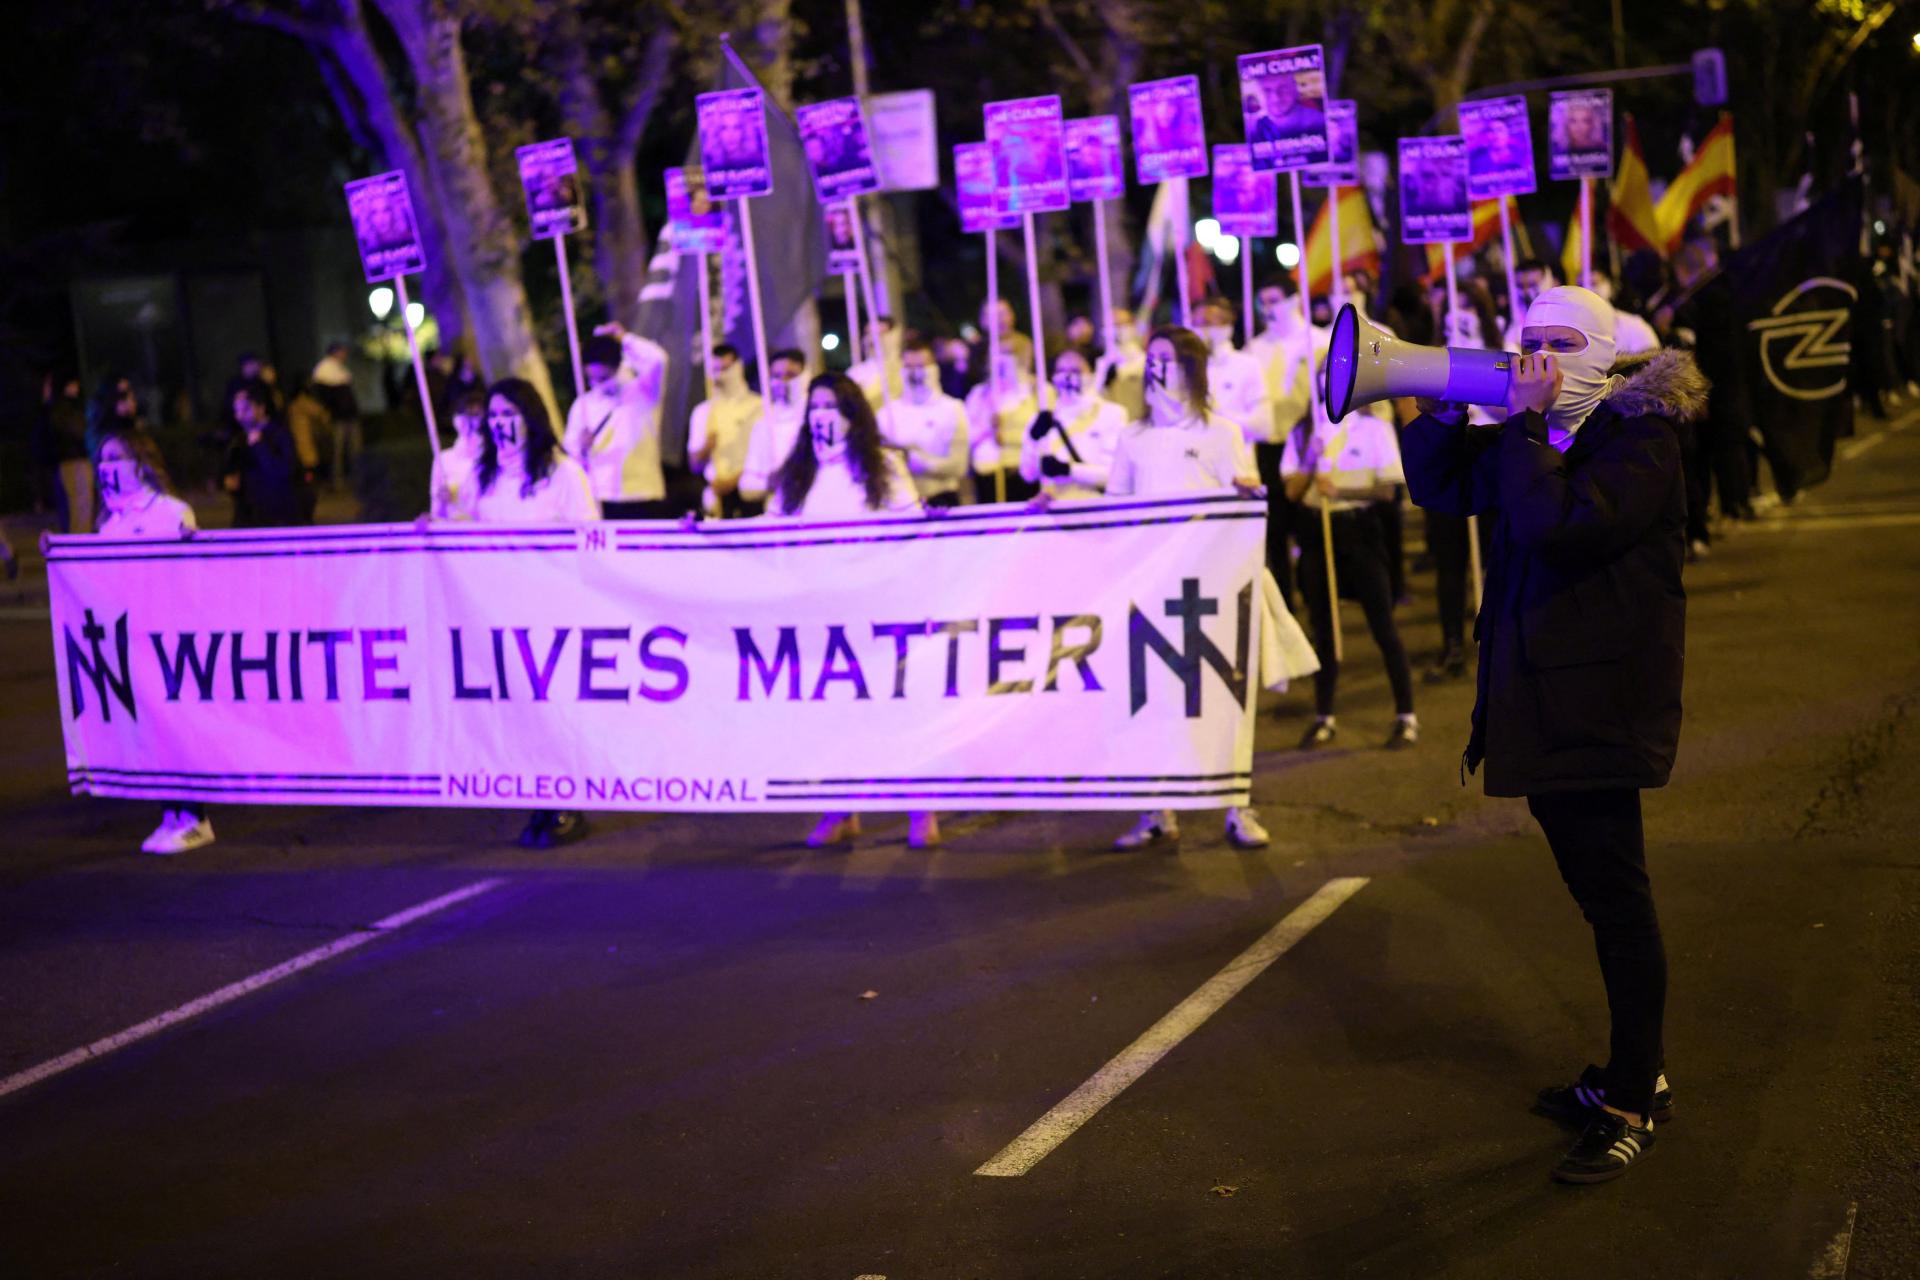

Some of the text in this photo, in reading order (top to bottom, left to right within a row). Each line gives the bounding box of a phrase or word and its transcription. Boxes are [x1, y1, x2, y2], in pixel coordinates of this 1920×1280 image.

[148, 626, 411, 702] WHITE
[449, 623, 691, 702] LIVES
[732, 613, 1107, 702] MATTER
[447, 768, 757, 802] NÚCLEO NACIONAL
